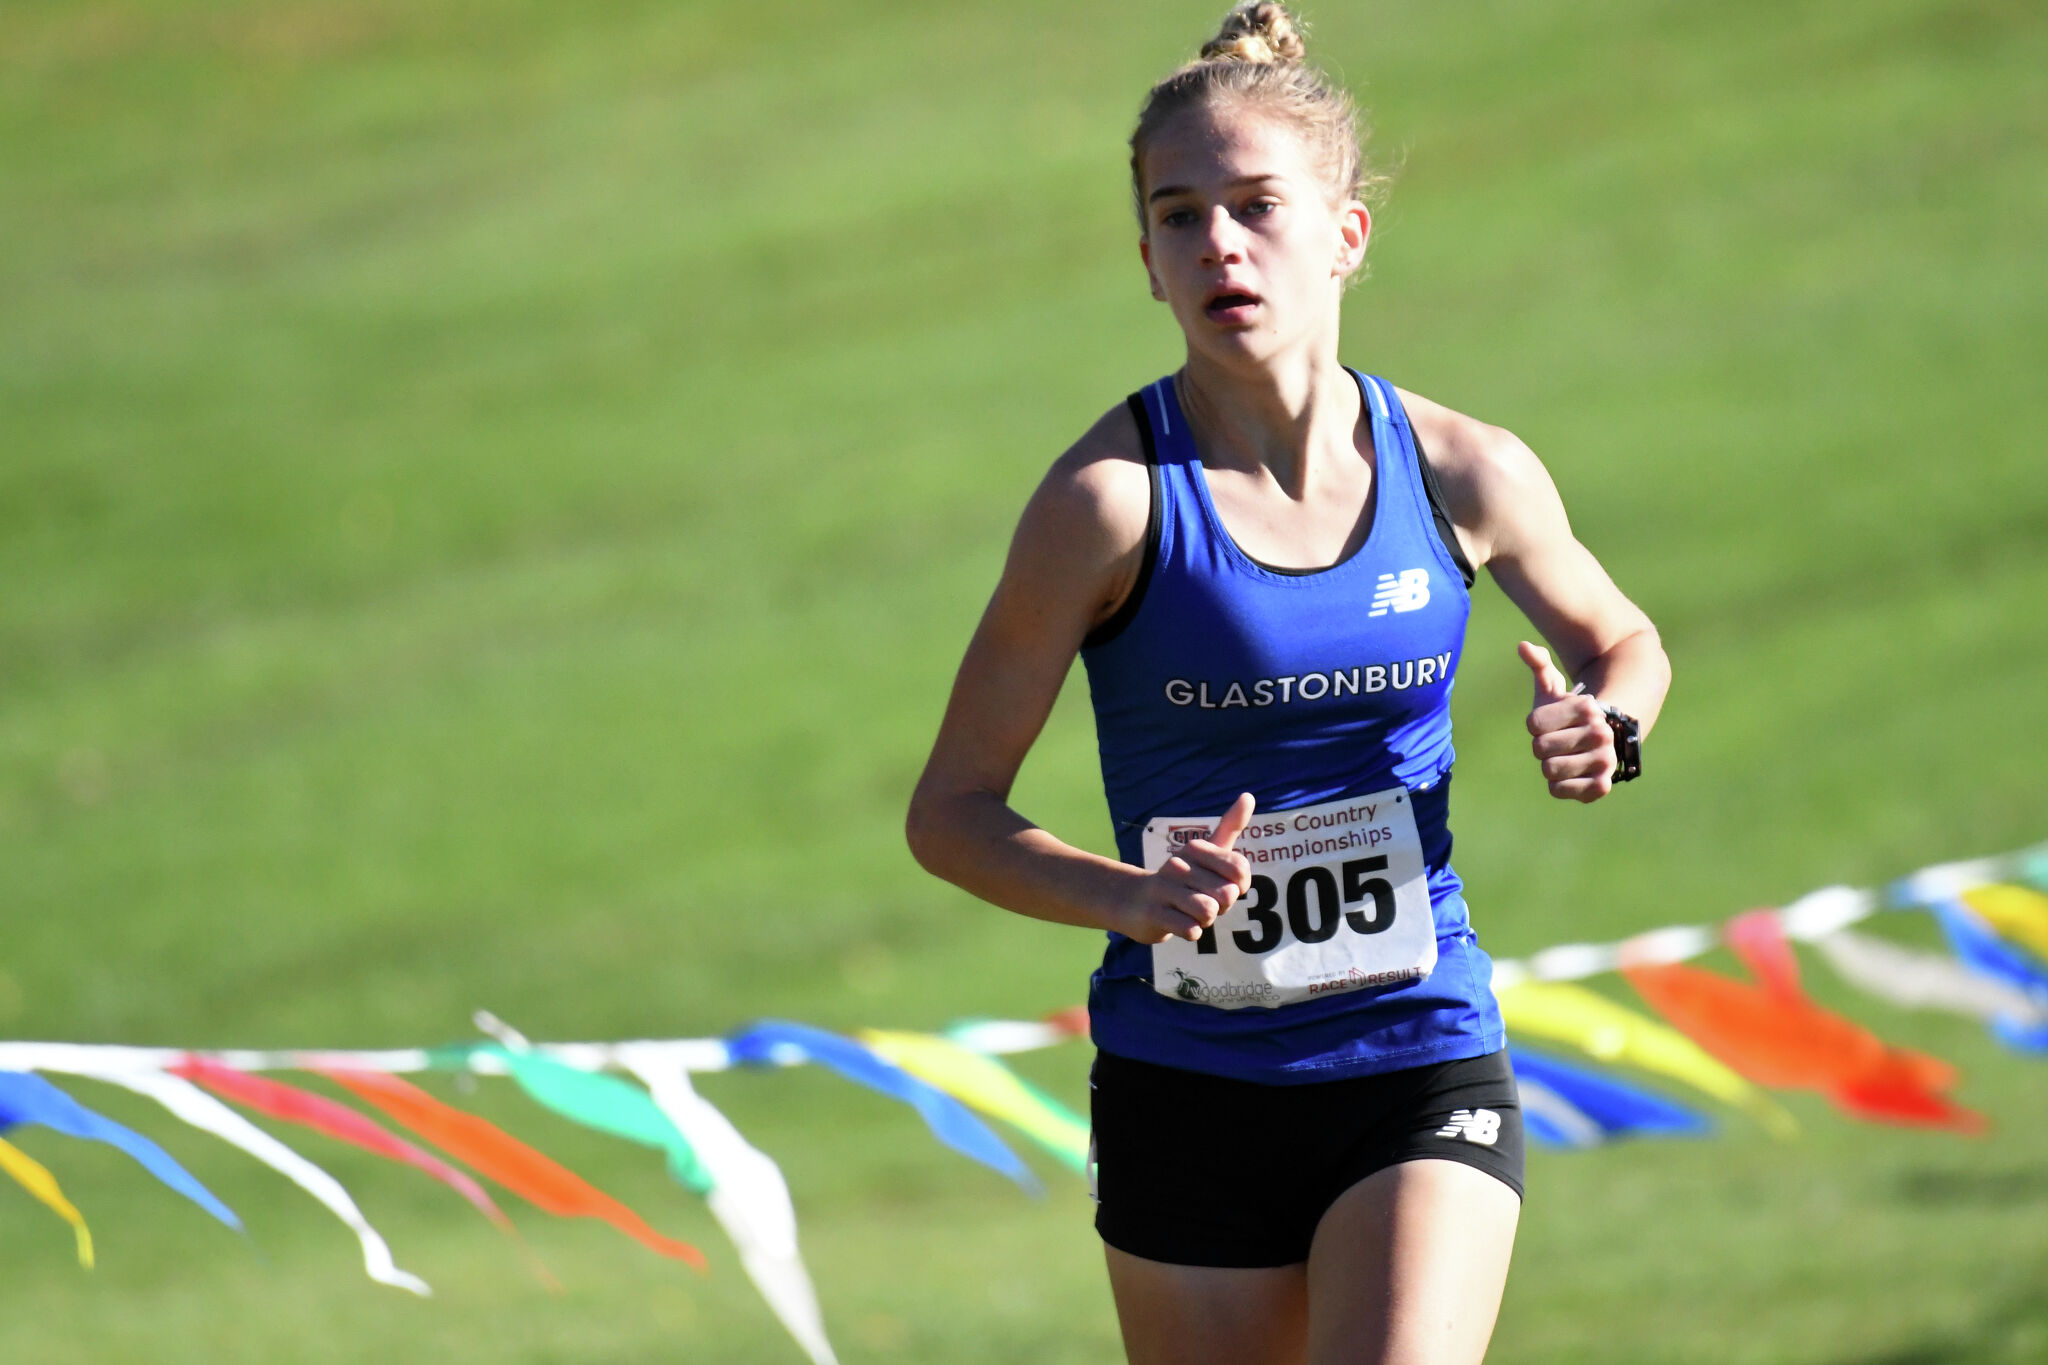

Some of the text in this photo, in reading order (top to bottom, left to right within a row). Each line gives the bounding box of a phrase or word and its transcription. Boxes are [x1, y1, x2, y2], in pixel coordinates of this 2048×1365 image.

[1368, 568, 1431, 618] NB
[1164, 650, 1453, 709] GLASTONBURY
[1238, 804, 1378, 841] ross Country
[1309, 966, 1422, 995] RACE RESULT
